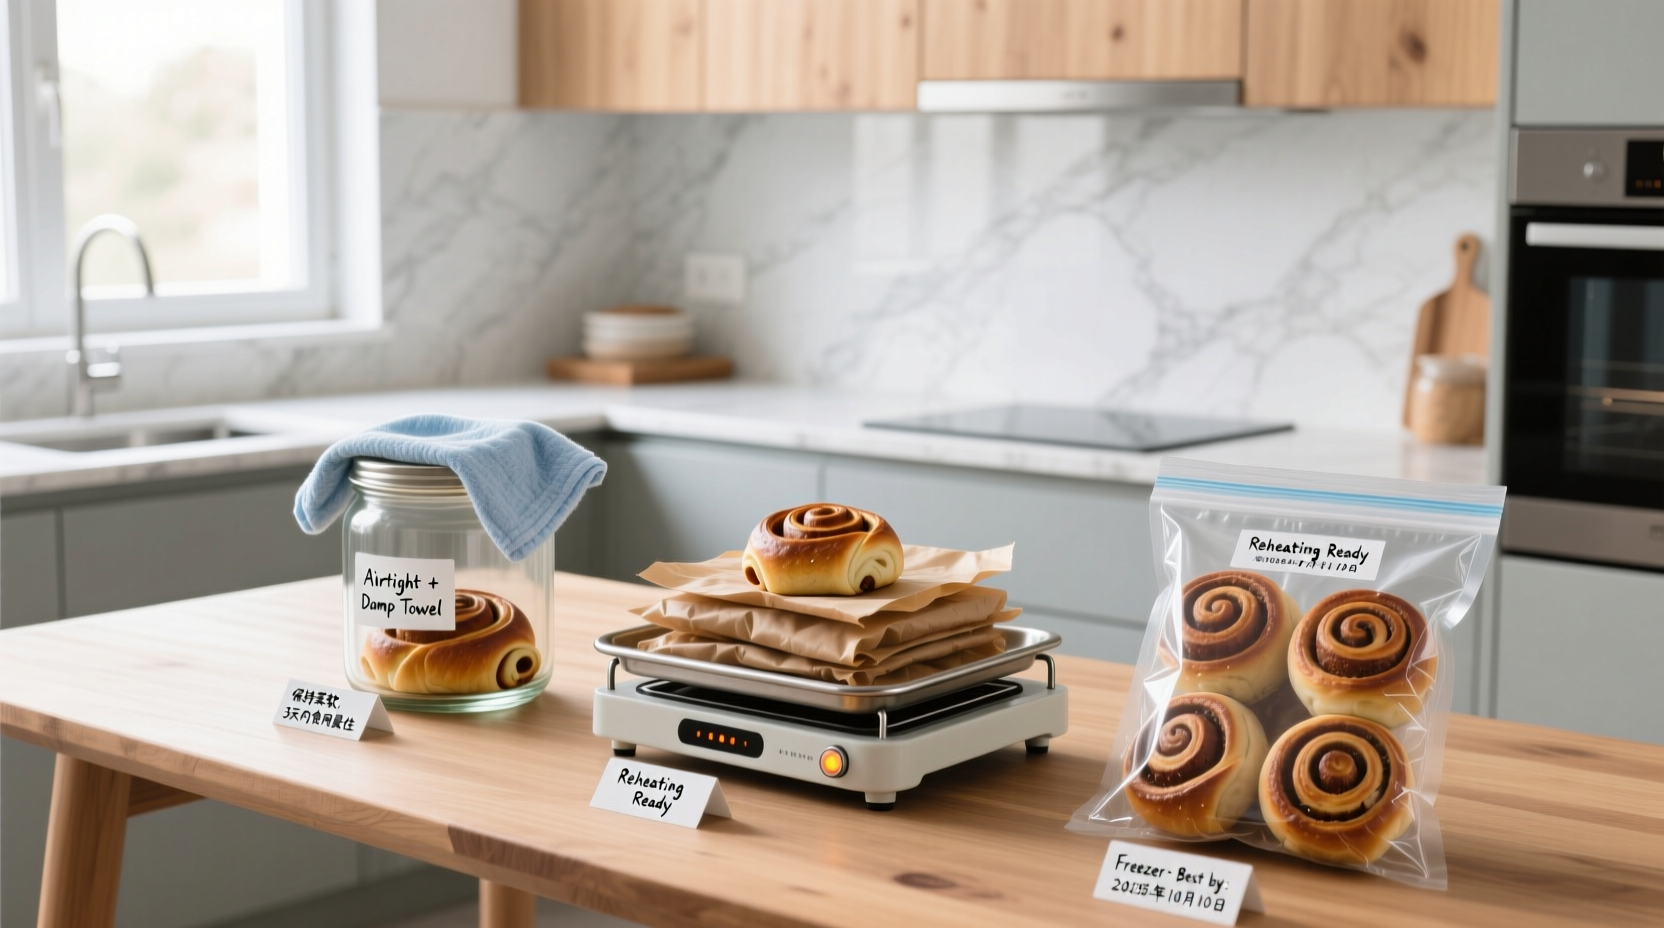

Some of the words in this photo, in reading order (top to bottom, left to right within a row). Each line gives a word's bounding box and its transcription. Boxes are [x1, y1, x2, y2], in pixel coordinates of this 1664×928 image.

[1249, 536, 1321, 562] Reheating
[1326, 543, 1369, 566] Ready
[363, 567, 421, 596] Airtight
[428, 576, 439, 590] +
[361, 593, 395, 619] Damp
[400, 597, 442, 617] Towel
[617, 767, 685, 801] Reheating
[632, 790, 673, 818] Ready
[1176, 867, 1204, 885] Best
